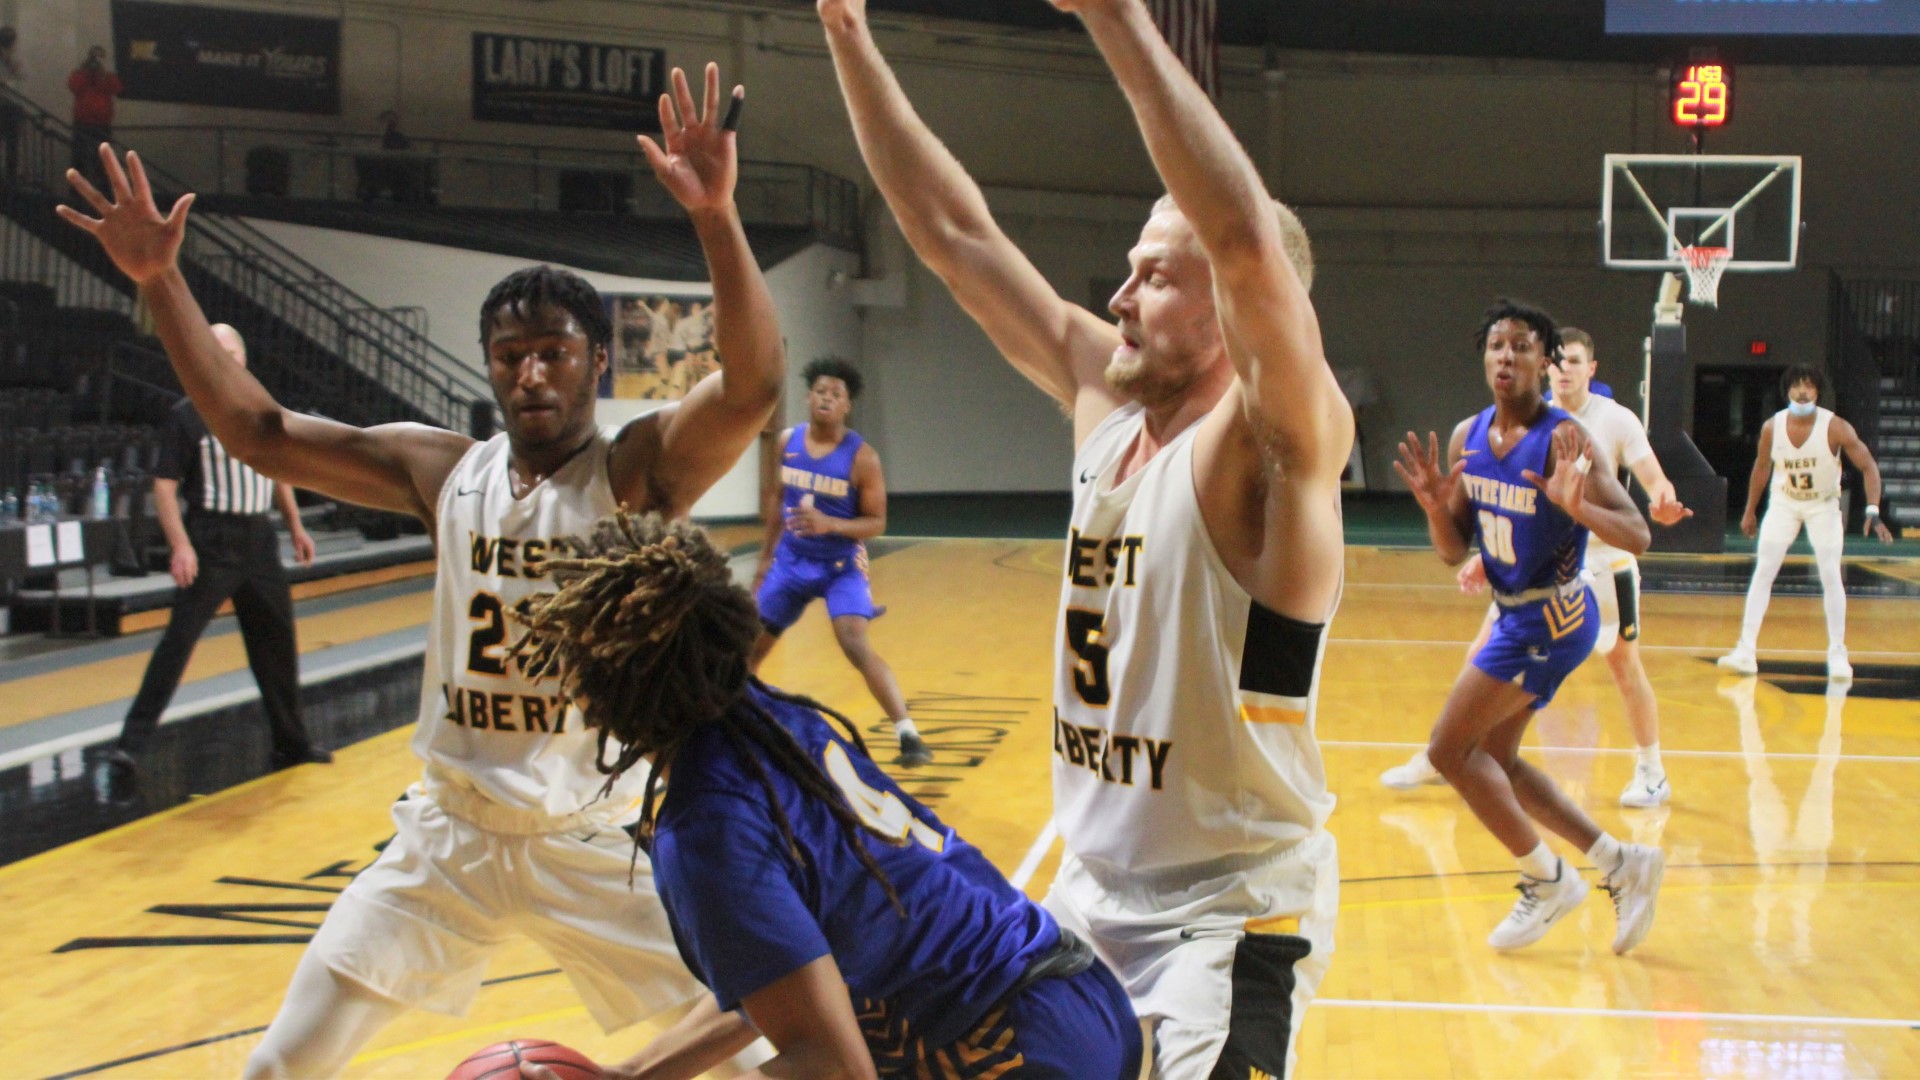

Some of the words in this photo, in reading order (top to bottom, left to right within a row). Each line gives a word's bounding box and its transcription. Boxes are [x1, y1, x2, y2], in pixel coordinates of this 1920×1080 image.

[483, 36, 582, 89] LARY'S
[590, 47, 655, 96] LOFT
[1677, 81, 1727, 121] 29
[1783, 457, 1817, 469] WEST
[1788, 472, 1814, 490] 13
[1499, 481, 1538, 515] DAME
[1068, 527, 1144, 588] EST
[1065, 606, 1112, 709] 5
[823, 738, 945, 854] 4
